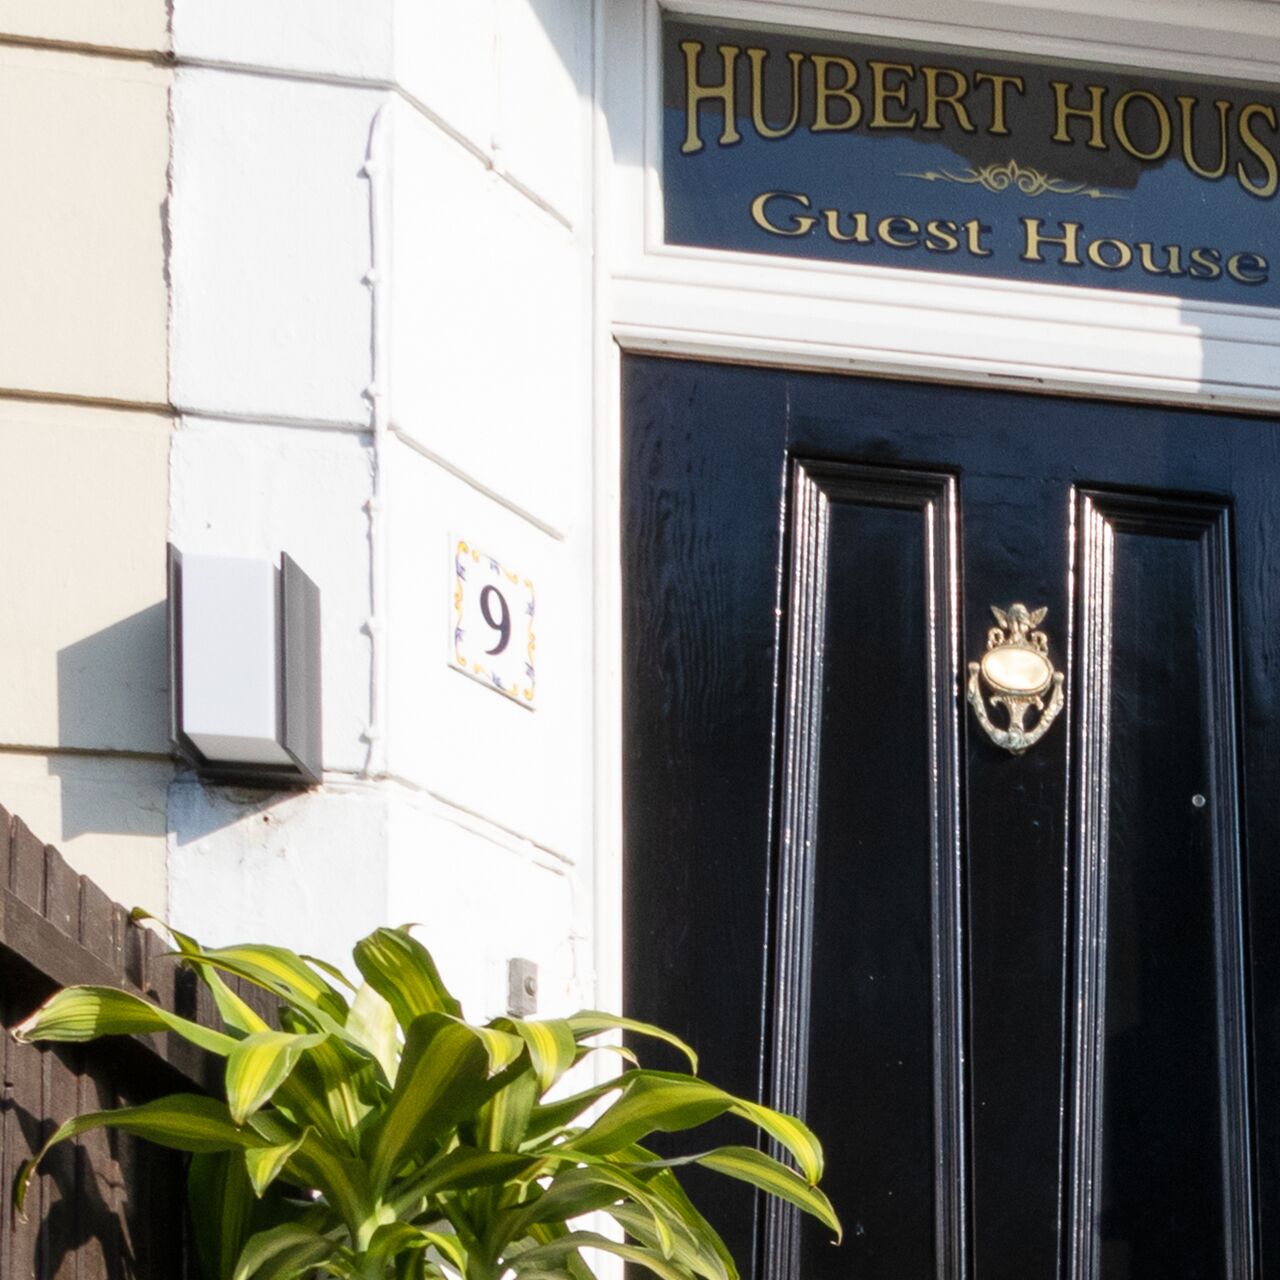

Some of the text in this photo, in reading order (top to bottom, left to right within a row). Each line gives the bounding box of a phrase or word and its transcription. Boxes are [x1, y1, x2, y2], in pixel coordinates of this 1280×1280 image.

[679, 40, 1024, 154] HUBERT
[750, 191, 1269, 284] Guest House
[480, 585, 511, 655] 9
